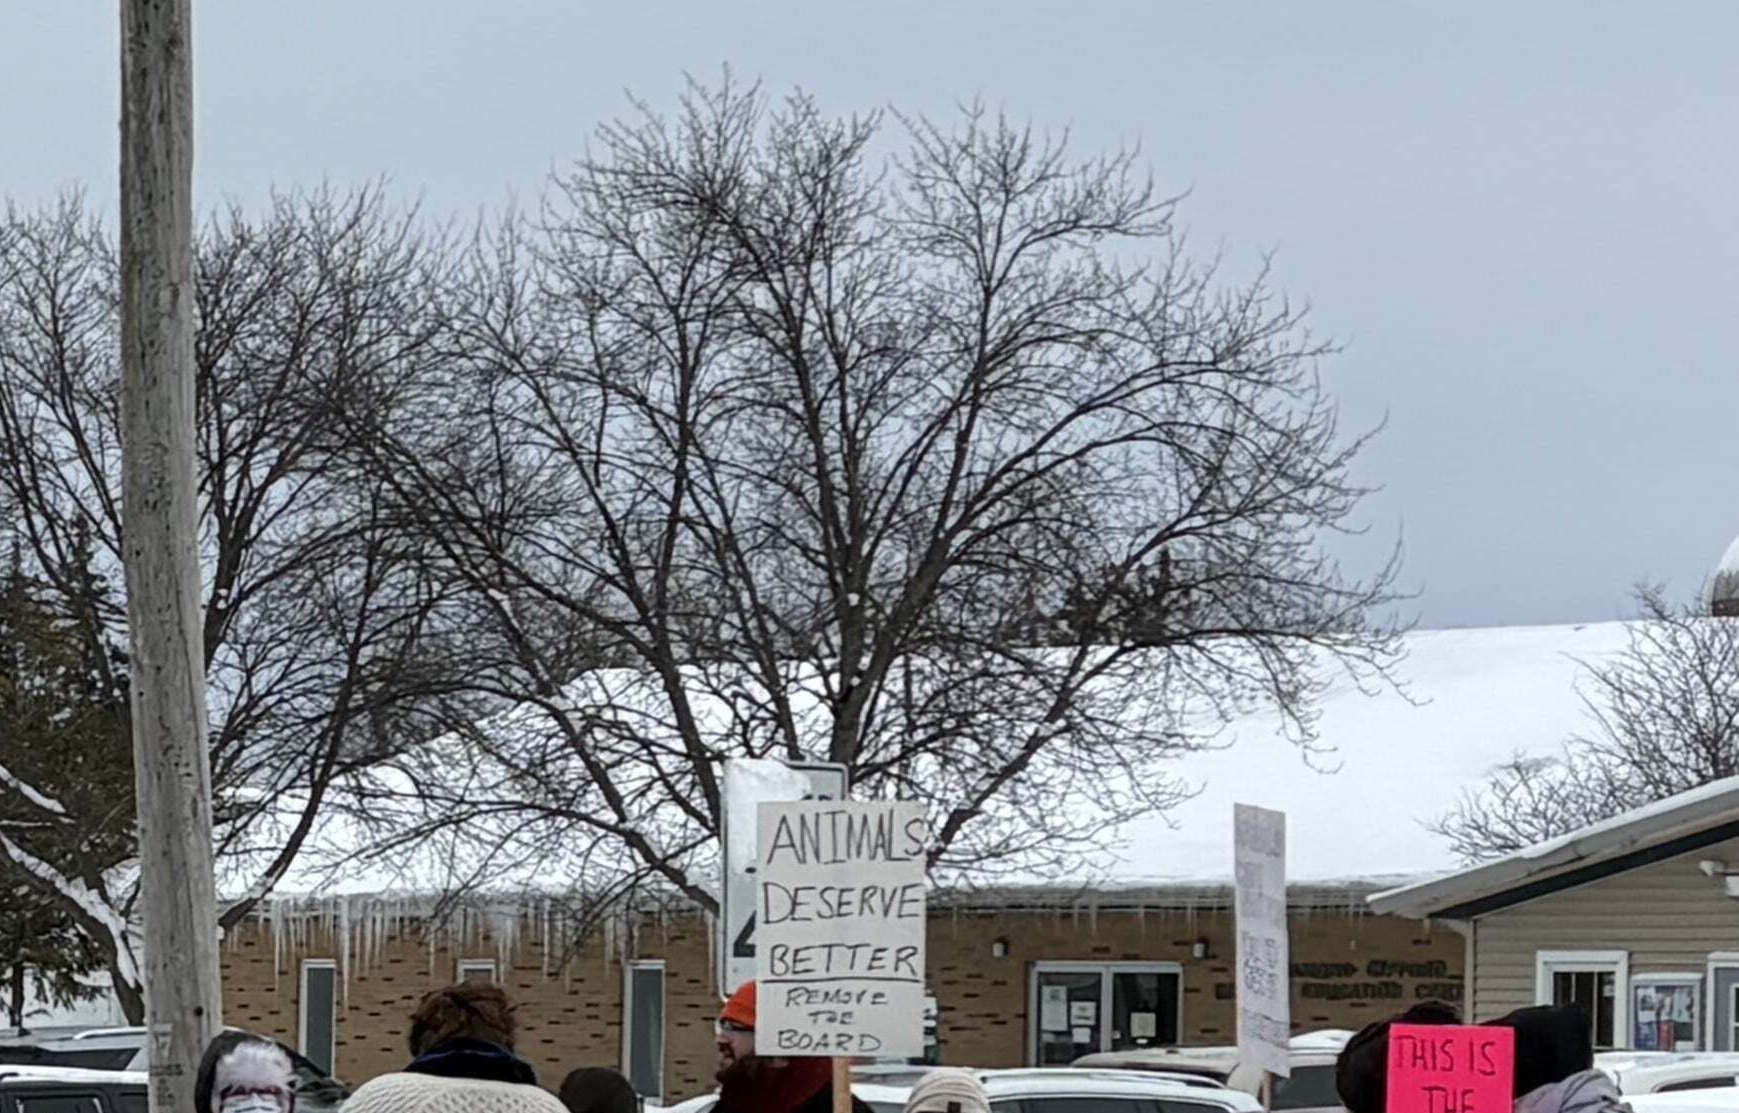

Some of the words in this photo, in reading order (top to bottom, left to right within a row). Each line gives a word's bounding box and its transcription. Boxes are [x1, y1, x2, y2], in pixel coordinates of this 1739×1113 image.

[767, 808, 926, 865] ANIMALS
[763, 882, 924, 924] DESERVE
[770, 944, 918, 977] BETTER
[785, 987, 889, 1008] REMOVE
[808, 1010, 855, 1025] THE
[777, 1030, 881, 1052] BOARD
[1395, 1035, 1454, 1073] THIS
[1469, 1041, 1496, 1076] IS
